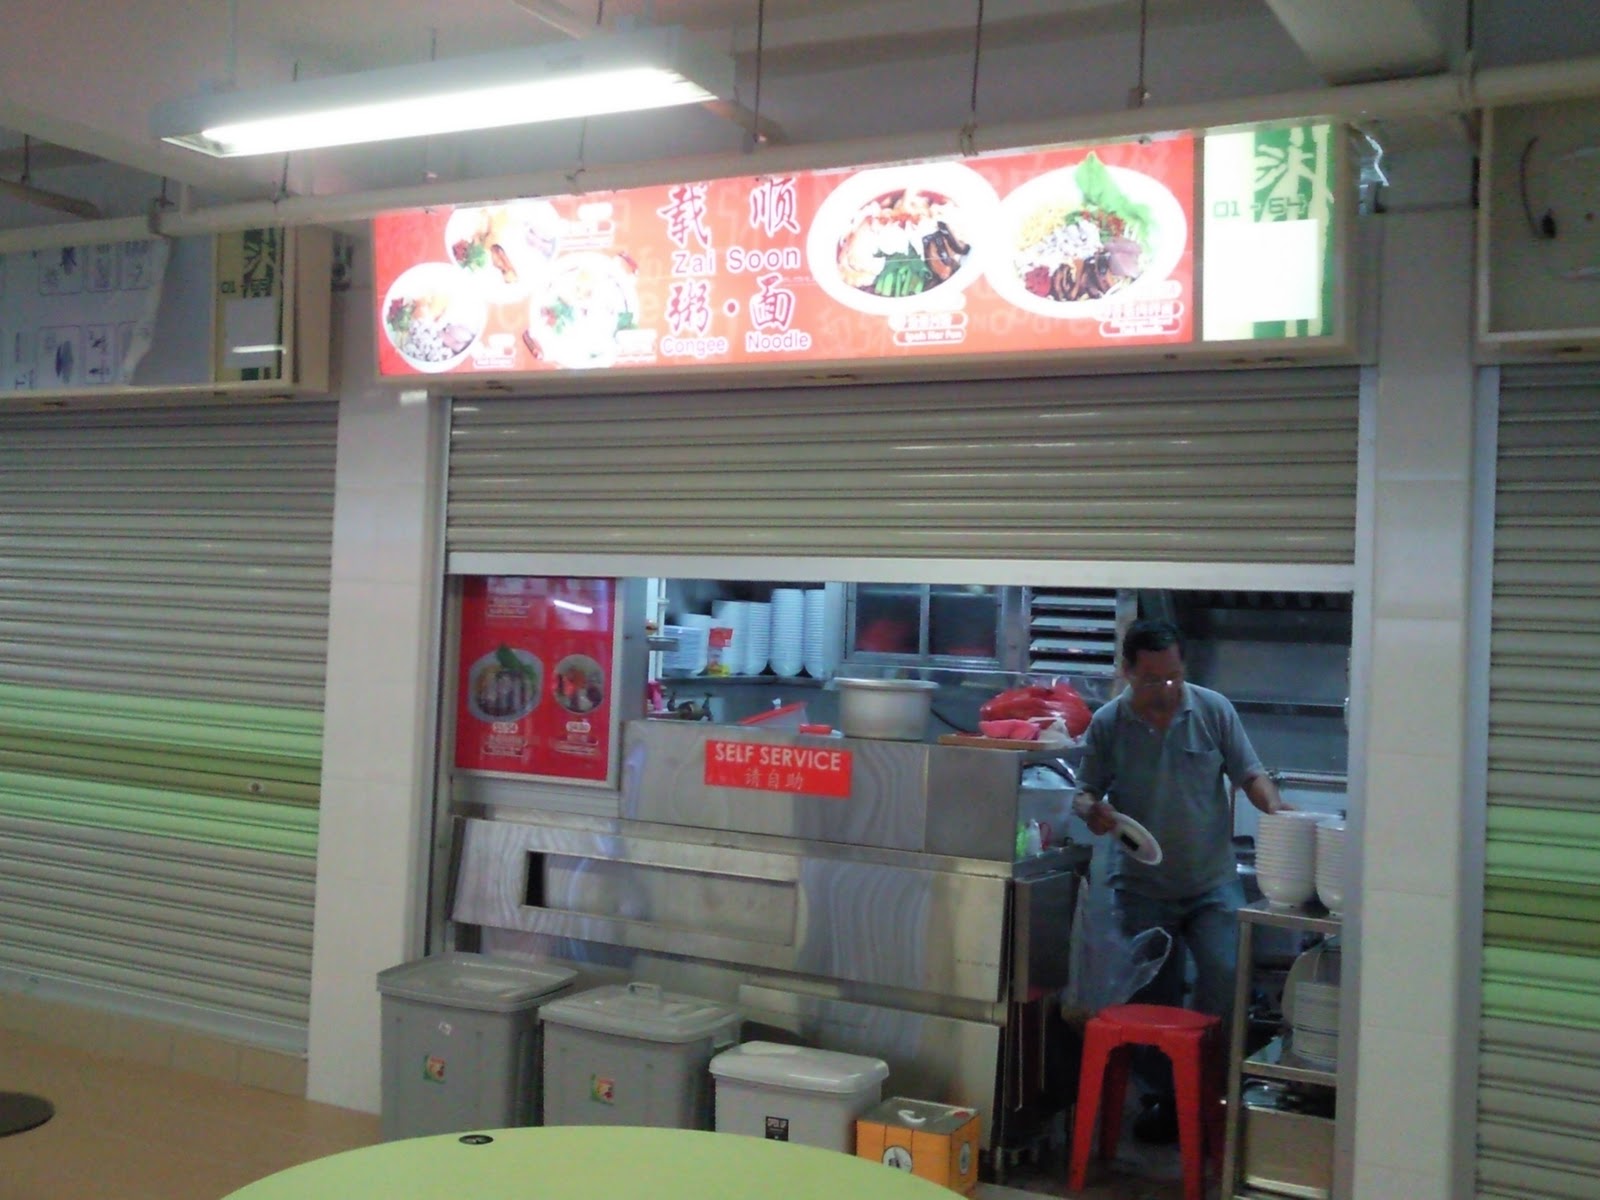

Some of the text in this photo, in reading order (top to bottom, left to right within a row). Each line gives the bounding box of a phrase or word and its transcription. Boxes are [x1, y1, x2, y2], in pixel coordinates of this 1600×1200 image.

[674, 248, 800, 274] Zai Soon
[667, 275, 793, 335] 粥 面
[662, 337, 728, 356] Congee
[747, 331, 811, 352] Noodle
[714, 743, 842, 771] SELF SERVICE
